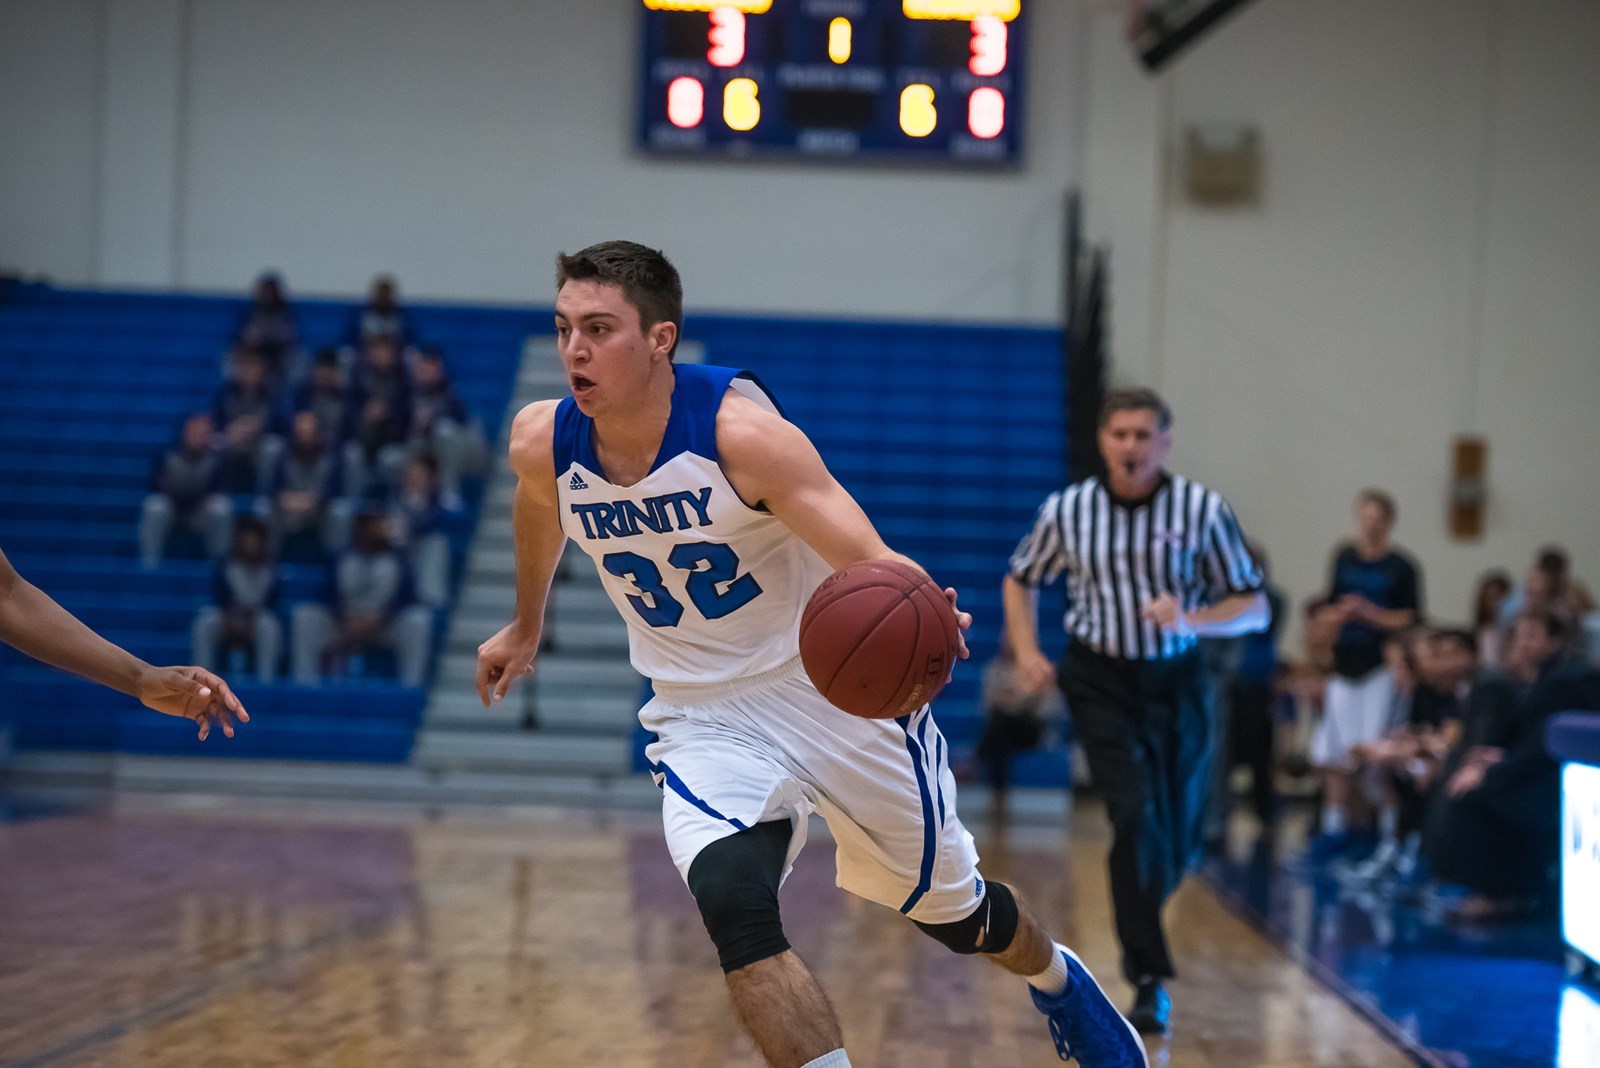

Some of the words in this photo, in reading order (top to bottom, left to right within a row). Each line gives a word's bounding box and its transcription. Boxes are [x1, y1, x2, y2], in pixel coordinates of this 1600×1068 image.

[723, 78, 761, 131] 6
[899, 84, 937, 137] 6
[570, 487, 713, 540] TRINITY
[602, 541, 764, 628] 32
